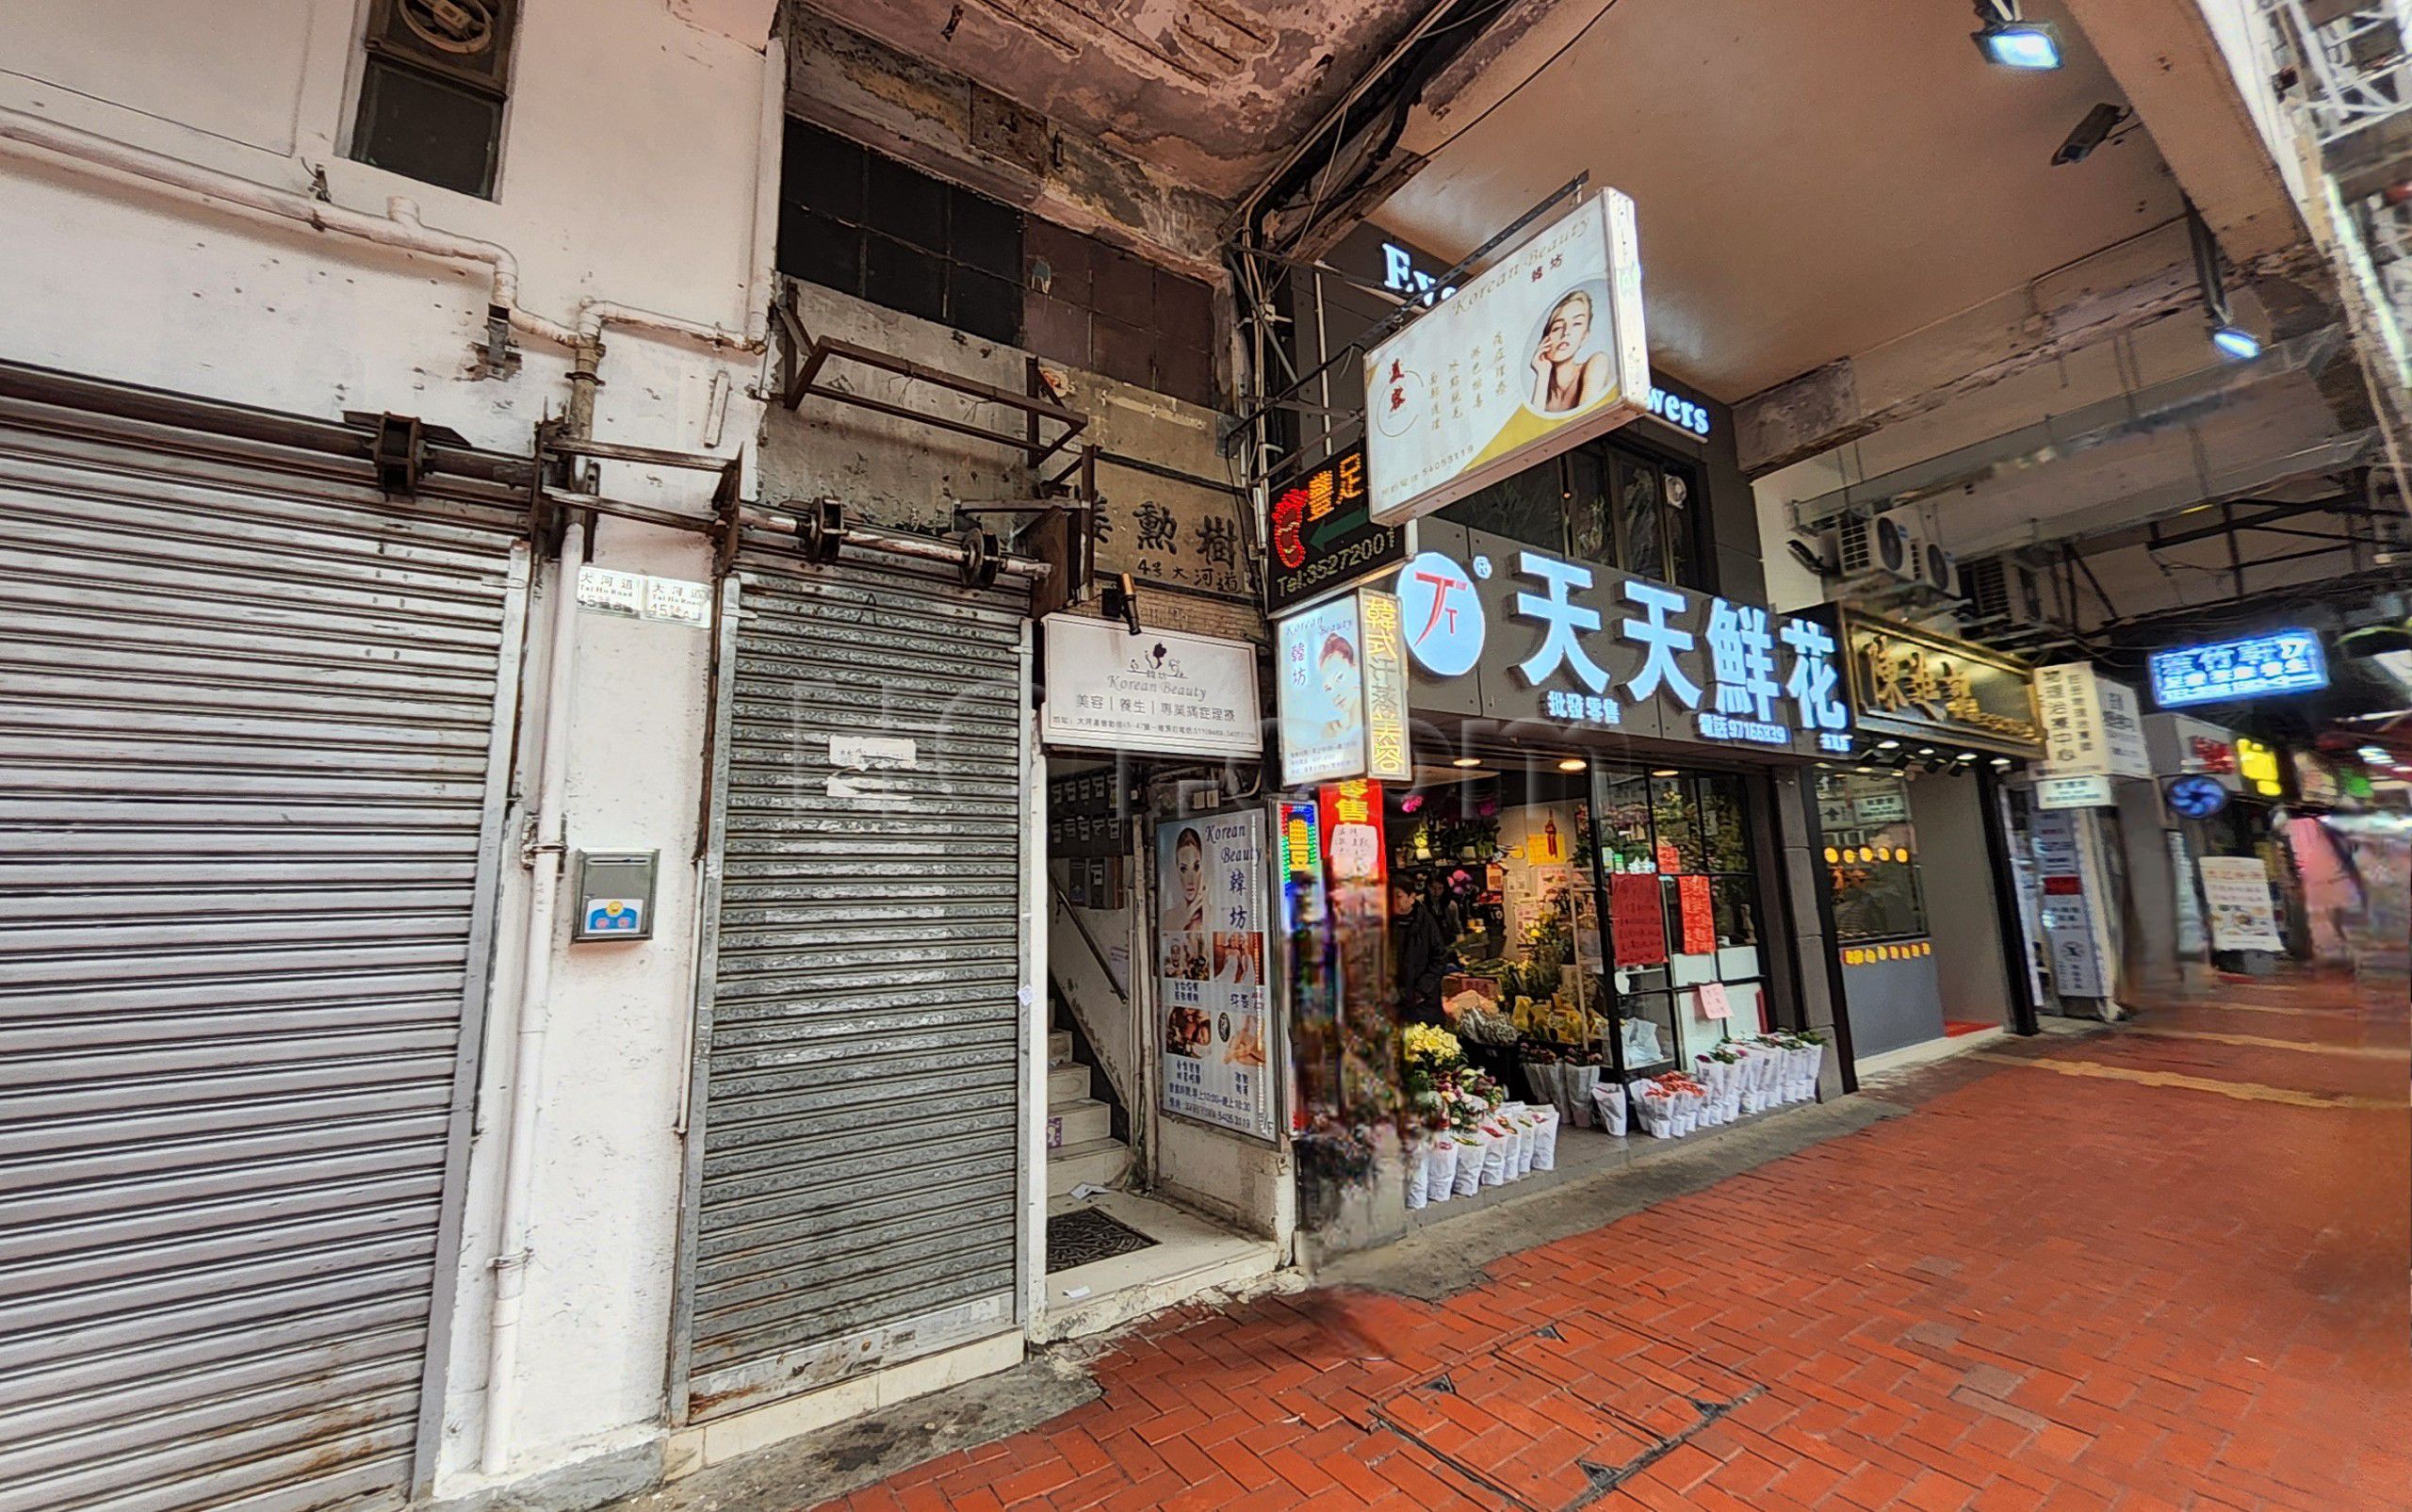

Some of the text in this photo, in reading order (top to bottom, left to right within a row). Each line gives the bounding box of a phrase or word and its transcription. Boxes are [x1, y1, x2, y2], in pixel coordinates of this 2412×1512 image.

[1451, 215, 1590, 317] Korean Beauty
[580, 572, 634, 590] 大河道
[1517, 550, 1848, 731] 天天鮮花
[1290, 642, 1309, 688] 韓坊
[1107, 675, 1207, 702] Korean Beauty
[1547, 690, 1621, 724] 批發零售
[1204, 823, 1247, 844] Korean
[1221, 845, 1263, 865] Beauty
[1229, 869, 1247, 930] 韓坊
